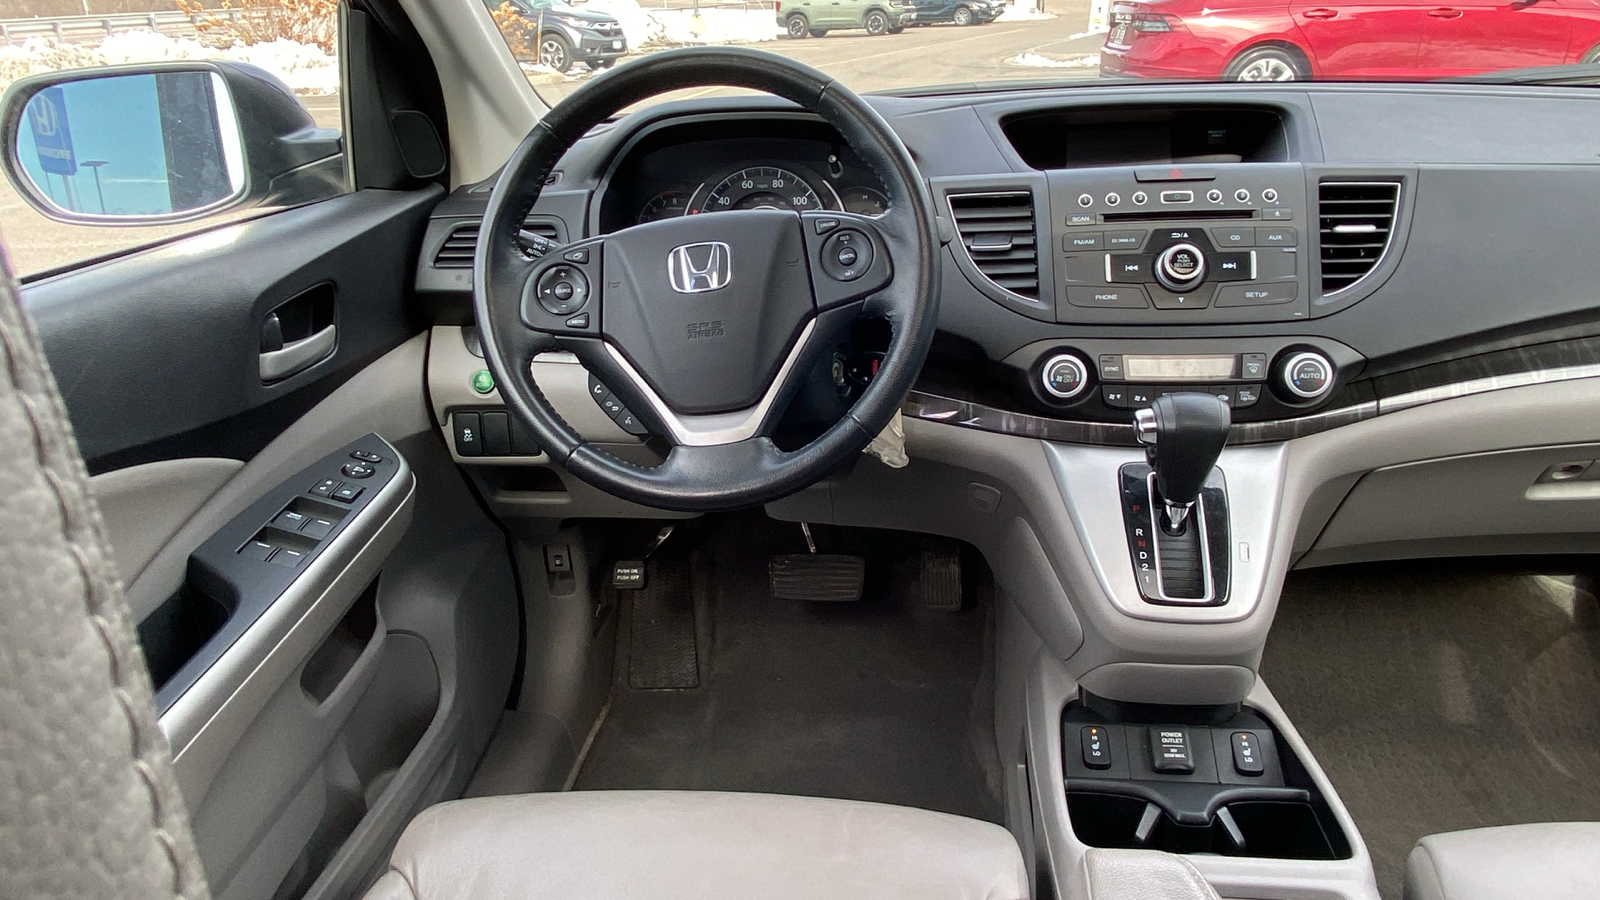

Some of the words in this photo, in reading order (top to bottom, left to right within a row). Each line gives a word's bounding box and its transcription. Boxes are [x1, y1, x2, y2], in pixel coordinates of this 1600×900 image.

[742, 180, 753, 189] 60
[772, 179, 784, 188] 80
[718, 197, 730, 205] 40
[792, 197, 808, 205] 100
[526, 248, 541, 257] AUTO
[687, 329, 725, 340] AIRBAG
[1135, 528, 1143, 536] R
[1139, 552, 1148, 560] D
